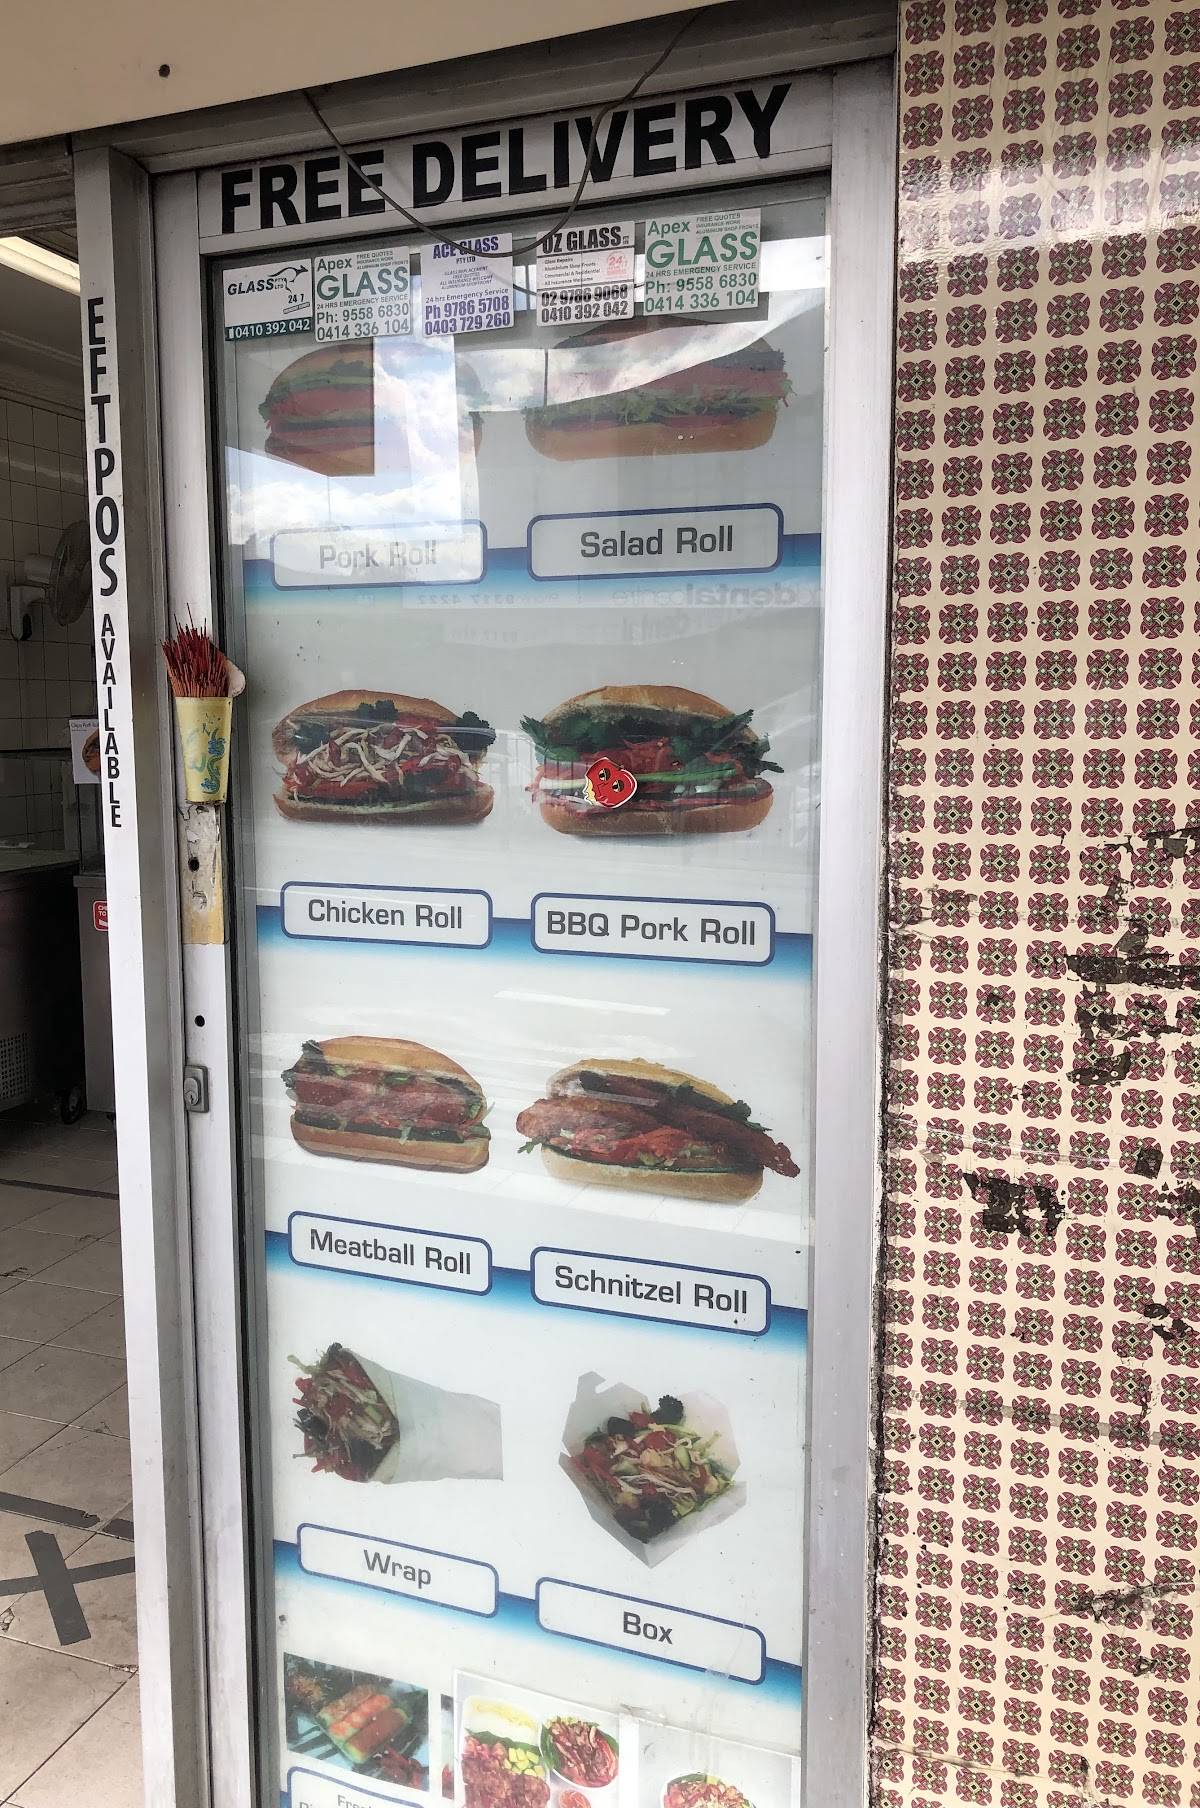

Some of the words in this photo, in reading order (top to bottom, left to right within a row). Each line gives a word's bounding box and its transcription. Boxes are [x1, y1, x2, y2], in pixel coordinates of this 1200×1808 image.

[222, 150, 385, 234] FREE
[412, 83, 792, 209] DELIVERY
[648, 220, 690, 238] Apex
[714, 213, 740, 221] QUOTES
[433, 243, 456, 260] ACE
[459, 236, 499, 256] GLASS
[542, 232, 563, 254] OZ
[566, 226, 621, 252] GLASS
[646, 231, 758, 269] GLASS
[316, 257, 352, 274] Apex
[674, 266, 721, 276] EMERGENCY
[723, 262, 756, 272] SERVICE
[227, 278, 274, 296] GLASS
[316, 266, 408, 301] GLASS
[446, 291, 483, 301] Emergency
[484, 288, 509, 296] Service
[541, 291, 557, 307] 02
[560, 287, 592, 305] 9786
[594, 284, 628, 302] 9068
[645, 280, 671, 295] Ph:
[676, 276, 713, 292] 9558
[719, 272, 757, 288] 6830
[288, 294, 297, 303] 24
[339, 298, 379, 308] EMERGENCY
[380, 293, 408, 303] SERVICE
[425, 304, 441, 320] Ph
[444, 299, 475, 318] 9786
[478, 295, 510, 314] 5708
[645, 295, 684, 313] 0414
[690, 292, 719, 309] 336
[726, 289, 756, 306] 104
[317, 311, 338, 324] Ph:
[342, 306, 373, 322] 9558
[378, 303, 409, 318] 6830
[425, 318, 457, 335] 0403
[459, 315, 483, 331] 729
[485, 311, 511, 328] 260
[541, 306, 572, 323] 0410
[575, 303, 601, 320] 392
[603, 300, 629, 317] 042
[235, 324, 263, 339] 0410
[265, 322, 287, 335] 392
[289, 318, 310, 332] 042
[317, 324, 350, 341] 0414
[354, 322, 379, 337] 336
[384, 318, 409, 334] 104
[87, 297, 119, 597] EFTPOS
[580, 528, 663, 558] Salad
[676, 524, 733, 554] Roll
[319, 543, 379, 569] Pork
[389, 539, 437, 567] Roll
[100, 613, 122, 828] AVAILABLE
[308, 898, 405, 926] Chicken
[415, 904, 463, 929] Roll
[547, 910, 610, 937] BBQ
[620, 914, 689, 942] Pork
[700, 918, 755, 946] Roll
[310, 1228, 414, 1266] Meatball
[425, 1246, 471, 1275] Roll
[554, 1265, 681, 1305] Schnitzel
[694, 1283, 747, 1314] Roll
[363, 1549, 432, 1590] Wrap
[623, 1610, 673, 1645] Box
